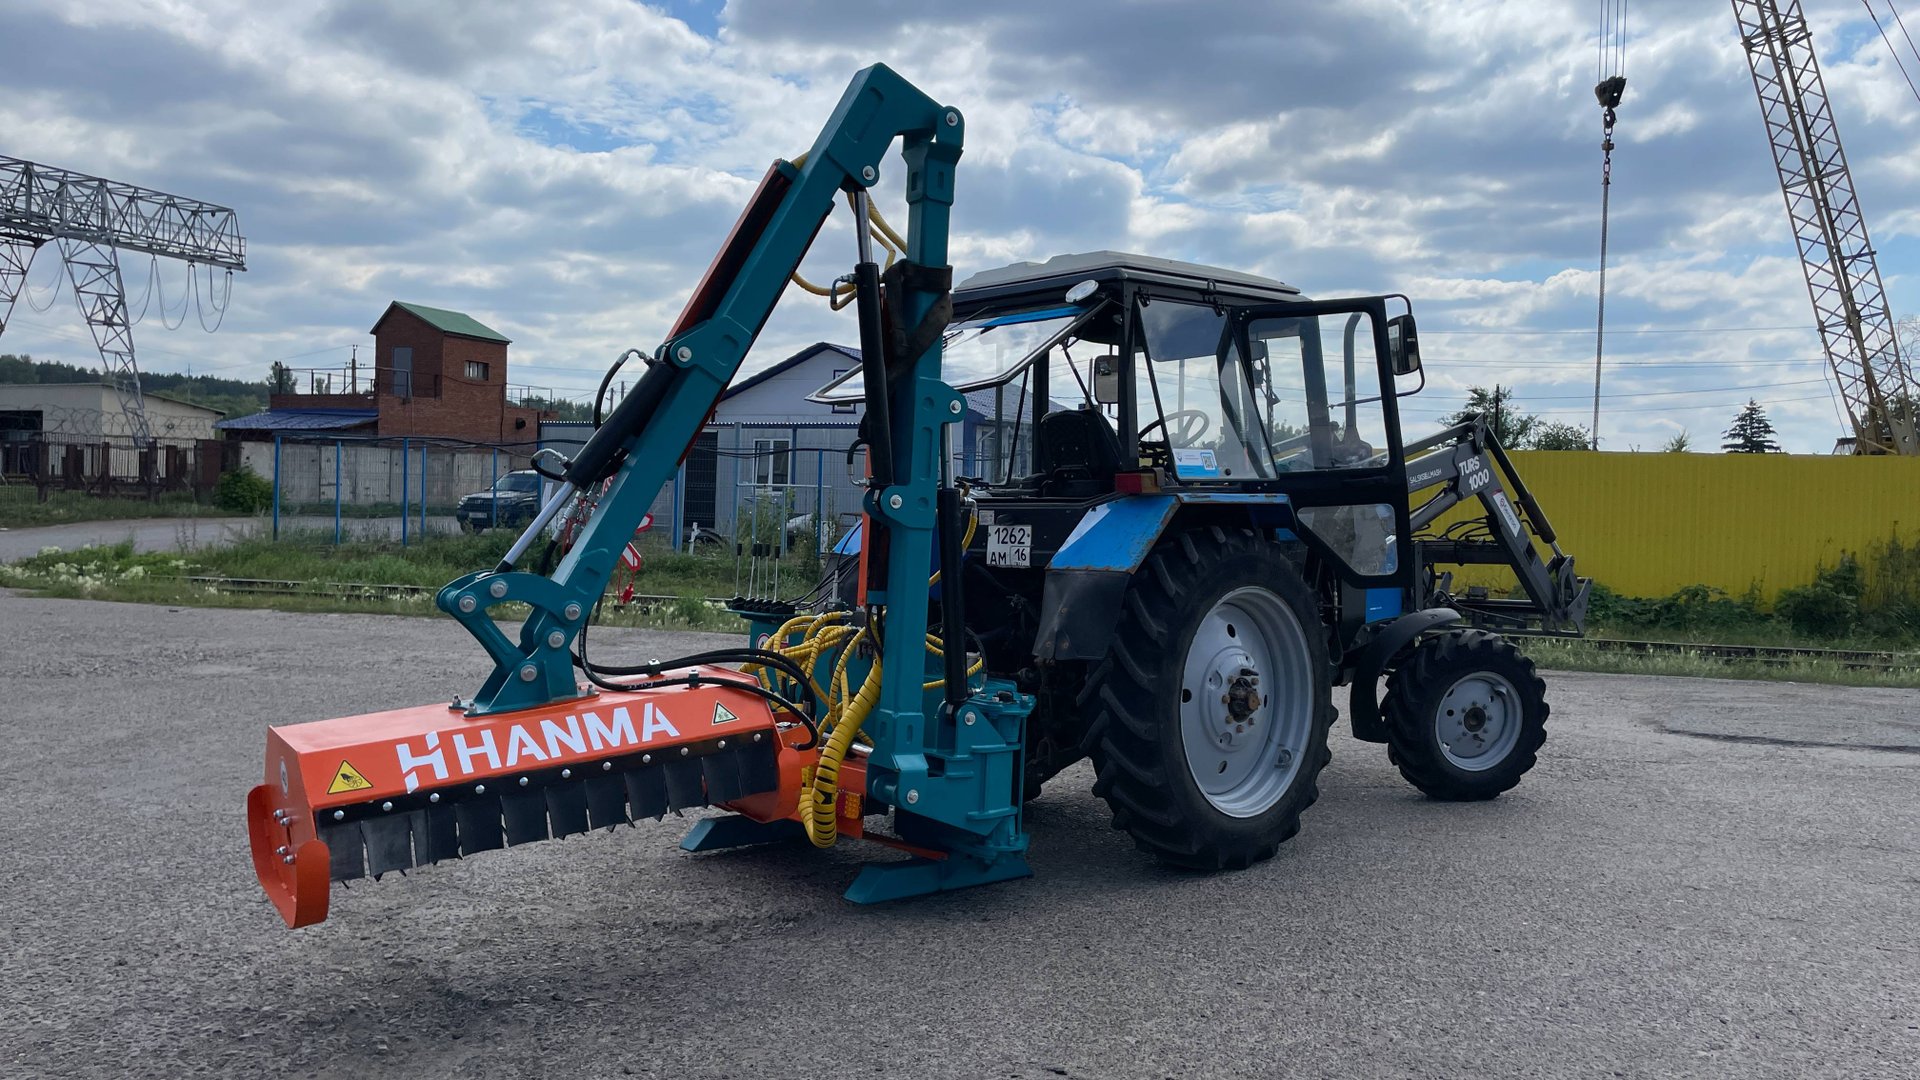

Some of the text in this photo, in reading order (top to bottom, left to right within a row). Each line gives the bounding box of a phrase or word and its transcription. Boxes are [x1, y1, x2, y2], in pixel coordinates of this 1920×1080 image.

[1459, 455, 1480, 476] TURS
[1469, 468, 1490, 490] 1000
[994, 527, 1026, 545] 1262
[1014, 548, 1027, 561] 16
[452, 702, 680, 774] HANMA
